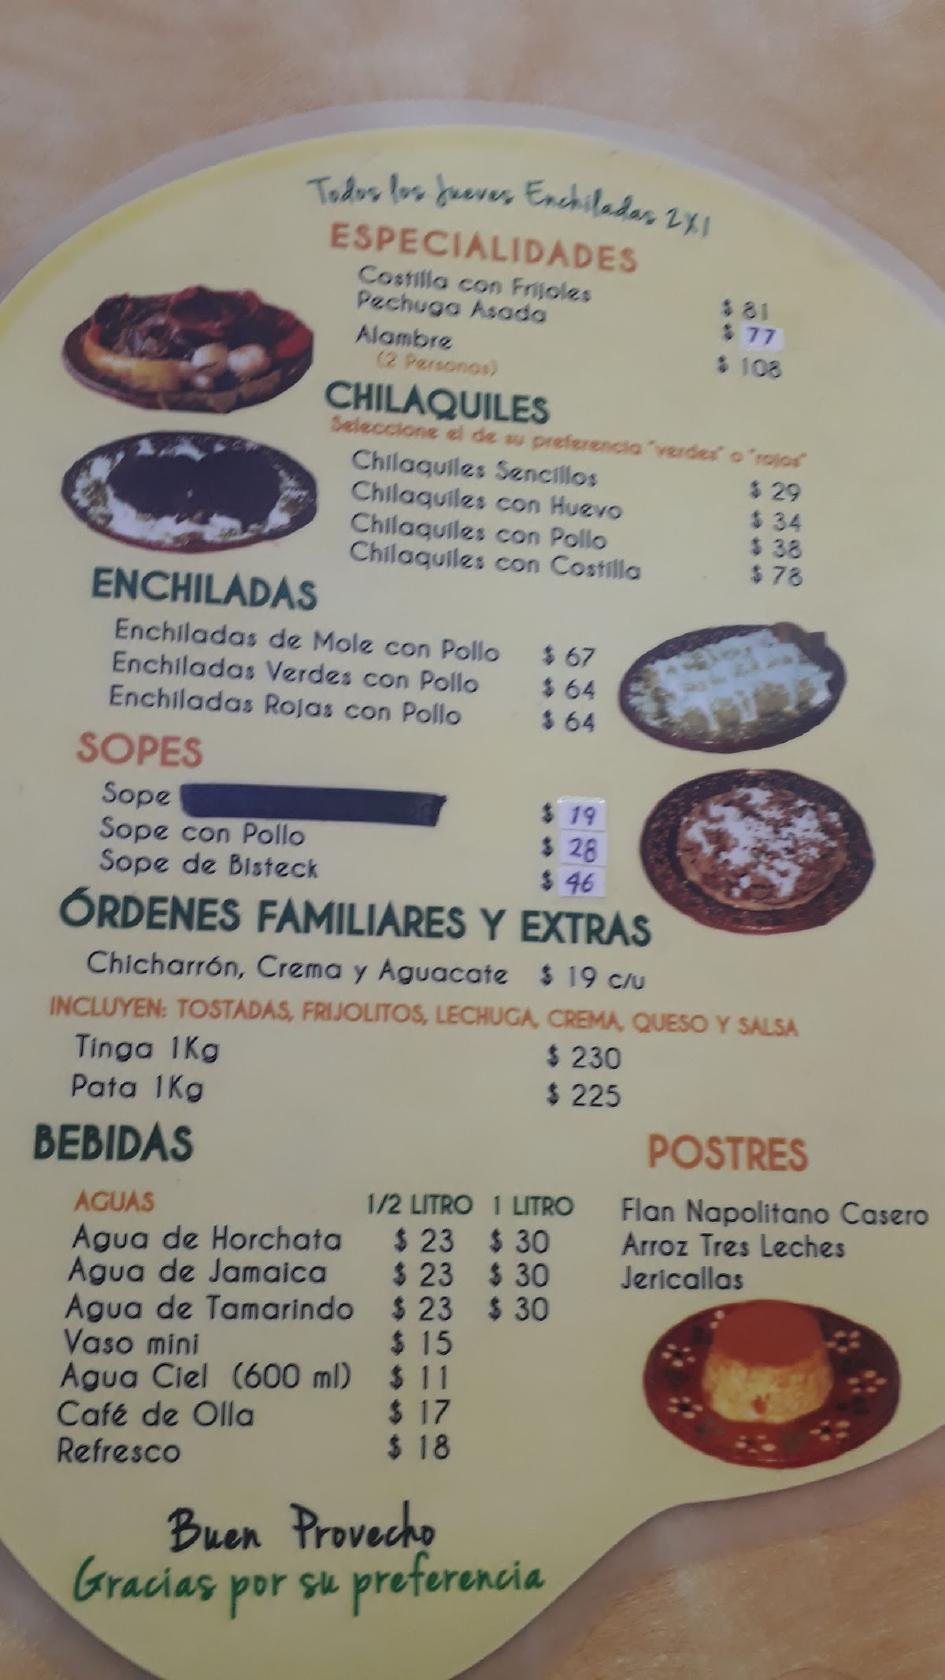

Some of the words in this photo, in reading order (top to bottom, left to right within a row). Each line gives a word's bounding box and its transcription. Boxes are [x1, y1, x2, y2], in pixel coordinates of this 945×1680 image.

[307, 176, 382, 203] Todos
[390, 173, 425, 203] los
[436, 174, 514, 208] Jueves
[525, 180, 656, 225] Enchiladas
[331, 222, 637, 273] ESPECIALIDADES
[358, 265, 448, 290] Costilla
[458, 279, 501, 294] con
[512, 278, 591, 303] Frijoles
[358, 290, 460, 318] Pechuga
[470, 300, 546, 324] Asada
[742, 301, 768, 320] 81
[356, 325, 452, 350] Alambre
[747, 327, 776, 344] 77
[743, 358, 782, 379] 108
[325, 380, 550, 424] CHILAQUILES
[331, 414, 438, 439] Seleccione
[446, 426, 463, 441] el
[472, 428, 496, 444] de
[505, 434, 525, 446] su
[532, 434, 642, 455] preferencia
[729, 451, 743, 463] o
[352, 449, 485, 479] Chilaquiles
[496, 460, 597, 487] Sencillos
[351, 480, 486, 509] Chilaquiles
[496, 497, 540, 513] con
[551, 496, 622, 520] Huevo
[772, 482, 801, 502] 29
[351, 512, 485, 541] Chilaquiles
[496, 529, 539, 544] con
[551, 527, 607, 550] Pollo
[774, 512, 801, 532] 34
[350, 541, 484, 570] Chilaquiles
[495, 557, 539, 573] con
[551, 555, 640, 580] Costilla
[774, 539, 802, 559] 38
[92, 567, 317, 611] ENCHILADAS
[774, 566, 803, 587] 78
[115, 617, 256, 647] Enchiladas
[269, 629, 301, 649] de
[314, 631, 373, 654] Mole
[385, 641, 430, 658] con
[442, 639, 499, 662] Pollo
[566, 647, 595, 667] 67
[113, 651, 254, 680] Enchiladas
[267, 661, 351, 685] Verdes
[363, 673, 408, 688] con
[421, 670, 479, 693] Pollo
[565, 679, 595, 699] 64
[110, 684, 253, 713] Enchiladas
[265, 693, 333, 718] Rojas
[345, 704, 390, 720] con
[403, 702, 461, 725] Pollo
[565, 711, 595, 732] 64
[76, 731, 203, 768] SOPES
[102, 781, 170, 808] Sope
[572, 806, 597, 825] 19
[100, 816, 168, 843] Sope
[182, 826, 229, 843] con
[241, 821, 307, 846] Pollo
[100, 848, 168, 876] Sope
[183, 853, 216, 874] de
[229, 854, 317, 878] Bisteck
[570, 838, 596, 863] 28
[566, 872, 593, 894] 46
[59, 886, 240, 932] ÓRDENES
[258, 898, 466, 939] FAMILIARES
[480, 908, 506, 940] Y
[521, 910, 651, 947] EXTRAS
[87, 950, 244, 979] Chicharrón,
[257, 955, 341, 979] Crema
[354, 966, 367, 984] y
[379, 959, 508, 985] Aguacate
[570, 966, 597, 988] 19
[608, 973, 644, 990] c/u
[50, 995, 167, 1018] INCLUYEN:
[177, 998, 294, 1022] TOSTADAS,
[302, 1001, 428, 1026] FRIJOLITOS,
[436, 1005, 539, 1029] LECHUGA,
[547, 1009, 624, 1032] CREMA,
[632, 1012, 708, 1033] QUESO
[716, 1015, 730, 1034] Y
[738, 1016, 798, 1037] SALSA
[76, 1034, 153, 1062] Tinga
[572, 1046, 621, 1069] 230
[72, 1074, 136, 1098] Pata
[573, 1084, 621, 1107] 225
[34, 1122, 194, 1162] BEBIDAS
[648, 1133, 809, 1172] POSTRES
[74, 1190, 154, 1212] AGUAS
[368, 1193, 401, 1214] 1/2
[411, 1194, 473, 1215] LITRO
[494, 1195, 500, 1215] 1
[514, 1196, 574, 1216] LITRO
[622, 1197, 674, 1222] Flan
[687, 1199, 829, 1227] Napolitano
[841, 1202, 928, 1225] Casero
[72, 1224, 148, 1253] Agua
[163, 1225, 198, 1250] de
[213, 1225, 341, 1251] Horchata
[421, 1228, 454, 1253] 23
[516, 1229, 549, 1254] 30
[622, 1232, 688, 1256] Arroz
[700, 1233, 749, 1257] Tres
[762, 1234, 845, 1258] Leches
[68, 1256, 144, 1286] Agua
[159, 1258, 194, 1282] de
[209, 1258, 326, 1283] Jamaica
[420, 1262, 453, 1287] 23
[516, 1263, 549, 1287] 30
[621, 1266, 743, 1290] Jericallas
[65, 1293, 142, 1323] Agua
[157, 1295, 192, 1320] de
[206, 1294, 354, 1320] Tamarindo
[420, 1296, 452, 1321] 23
[515, 1297, 548, 1321] 30
[64, 1329, 133, 1354] Vaso
[147, 1334, 199, 1355] mini
[424, 1330, 452, 1355] 15
[60, 1362, 137, 1392] Agua
[153, 1362, 207, 1388] Ciel
[233, 1362, 300, 1389] (600
[313, 1362, 351, 1389] ml)
[422, 1365, 447, 1390] 11
[57, 1400, 127, 1426] Café
[142, 1401, 178, 1426] de
[193, 1400, 254, 1427] Olla
[422, 1399, 450, 1424] 17
[58, 1437, 180, 1463] Refresco
[421, 1434, 450, 1460] 18
[168, 1507, 261, 1553] Buen
[290, 1500, 435, 1549] Provecho
[73, 1555, 217, 1602] Gracias
[230, 1573, 287, 1620] por
[299, 1573, 339, 1600] su
[353, 1550, 550, 1617] preferencia
